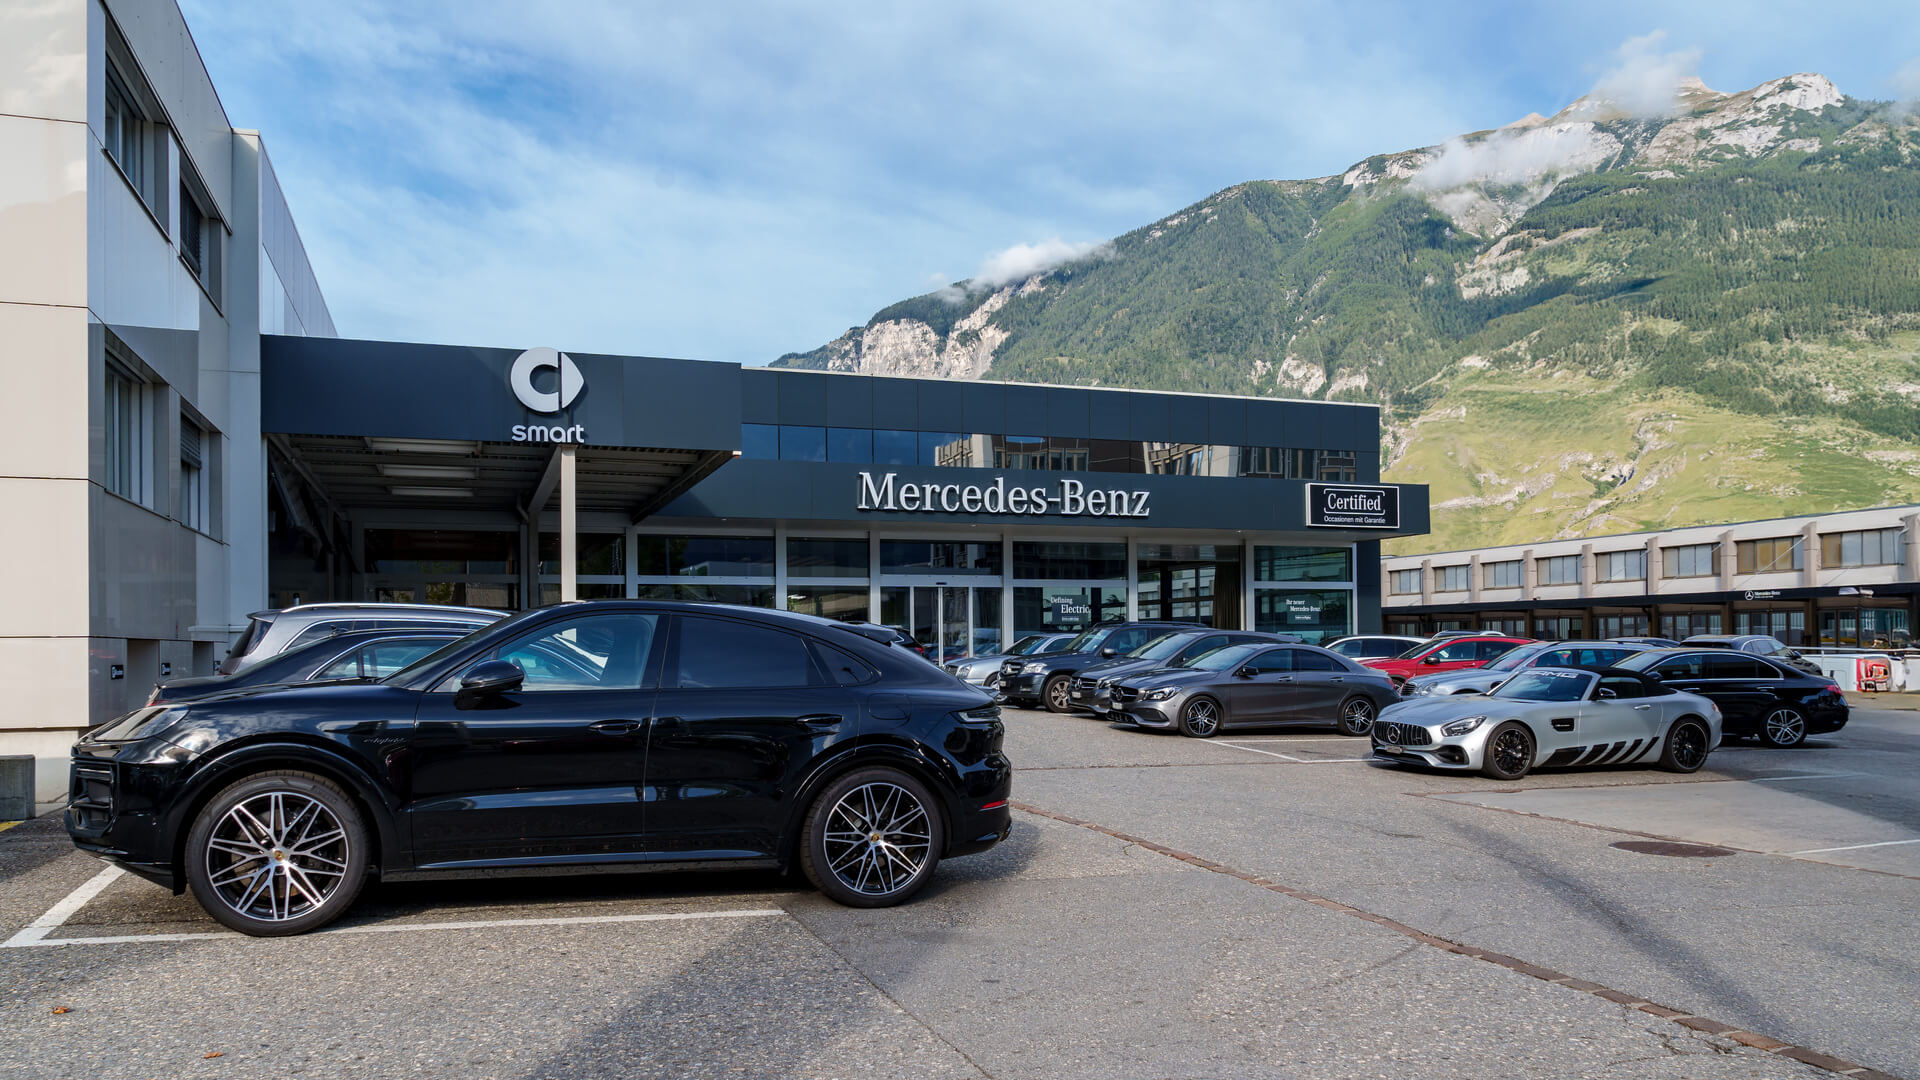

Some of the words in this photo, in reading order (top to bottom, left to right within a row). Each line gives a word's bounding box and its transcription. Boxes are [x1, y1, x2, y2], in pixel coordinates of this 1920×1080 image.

[511, 424, 585, 443] smart
[857, 471, 1150, 517] Mercedes-Benz
[1327, 493, 1382, 511] Certified
[1323, 515, 1354, 523] Occasionen
[1050, 596, 1073, 605] Defining
